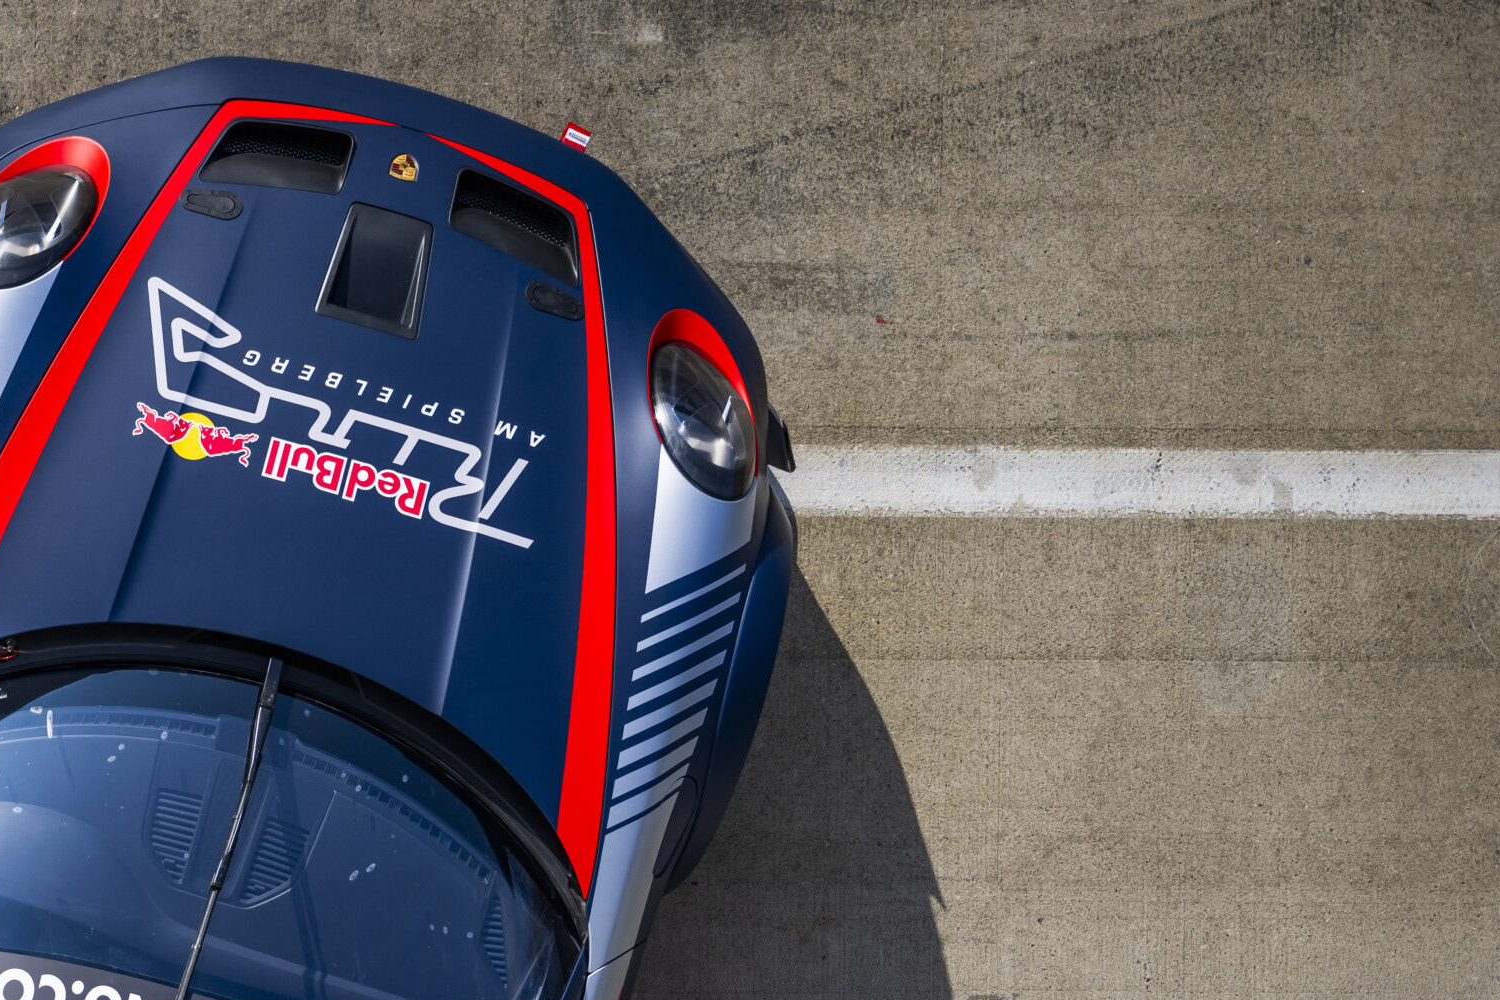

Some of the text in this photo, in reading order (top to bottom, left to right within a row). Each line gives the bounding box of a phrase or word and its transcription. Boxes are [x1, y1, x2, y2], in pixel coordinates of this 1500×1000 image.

[242, 349, 547, 449] AM SPIELBERG
[262, 436, 432, 520] Red Bull
